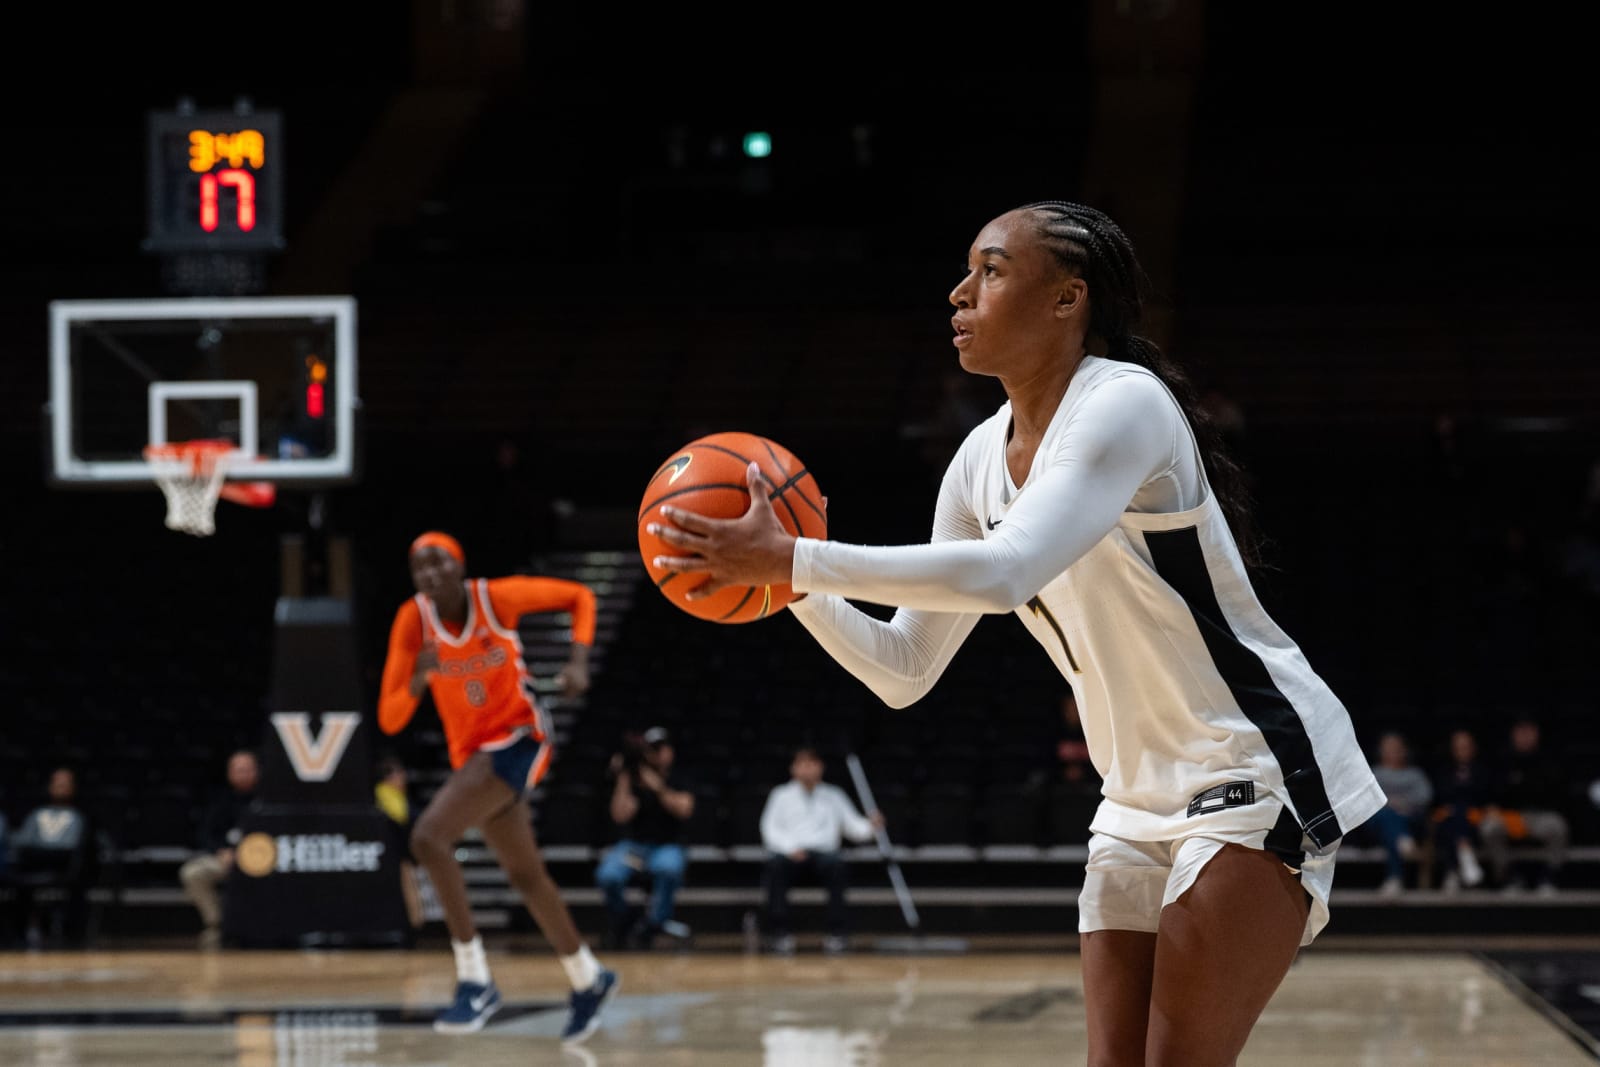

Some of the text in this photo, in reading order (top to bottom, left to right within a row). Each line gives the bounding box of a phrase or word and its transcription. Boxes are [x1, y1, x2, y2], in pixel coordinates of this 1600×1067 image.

[200, 168, 256, 233] 17
[270, 711, 362, 782] V
[1228, 789, 1242, 800] 44
[275, 834, 385, 873] Hiller
